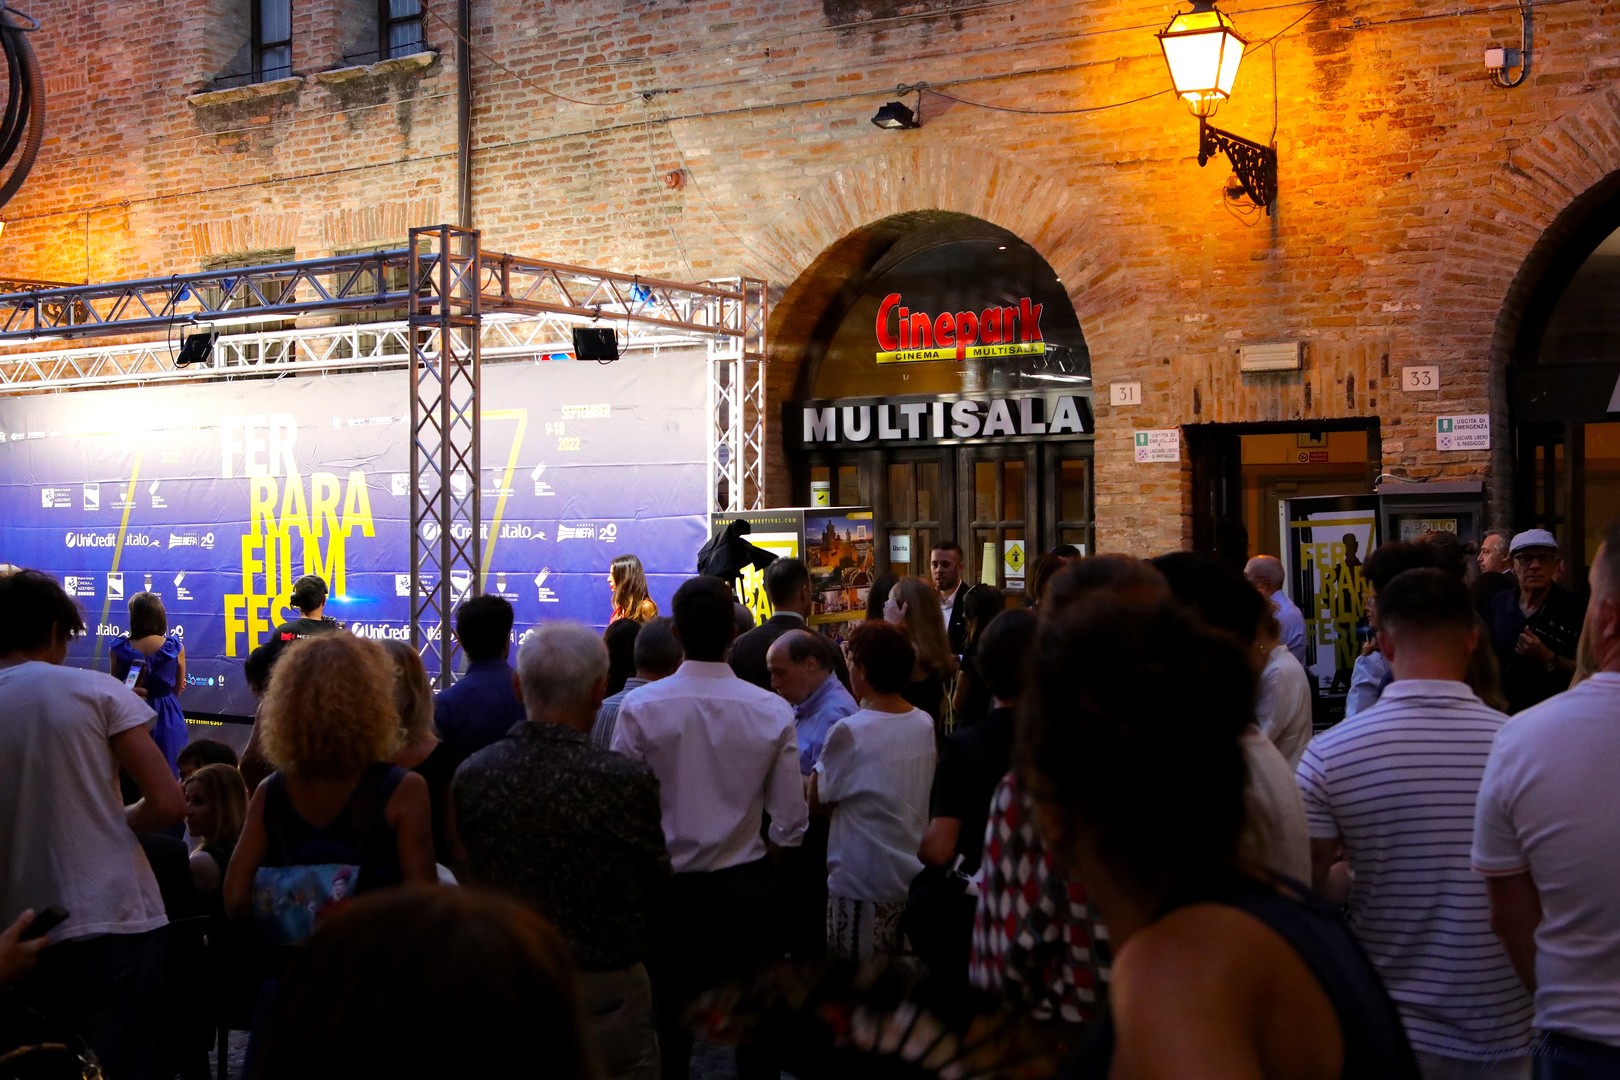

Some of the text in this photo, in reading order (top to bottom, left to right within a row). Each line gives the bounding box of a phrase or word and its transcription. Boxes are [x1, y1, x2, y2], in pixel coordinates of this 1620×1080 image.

[876, 293, 1044, 362] Cinepark
[895, 346, 1038, 361] CINEMA MULTISALA
[1410, 371, 1432, 386] 33
[1119, 386, 1133, 401] 31
[561, 404, 611, 419] SEPTEMBER
[803, 395, 1084, 442] MULTISALA
[545, 422, 565, 436] 9-18
[221, 412, 300, 478] FER
[557, 437, 581, 451] 2022
[250, 471, 376, 537] RARA
[1403, 522, 1456, 533] APOLLO
[76, 533, 116, 547] UniCredit
[125, 533, 149, 546] italo
[892, 544, 908, 552] Uscita
[1300, 542, 1346, 570] FER
[241, 534, 346, 598] FILM
[365, 623, 410, 640] UniCredi
